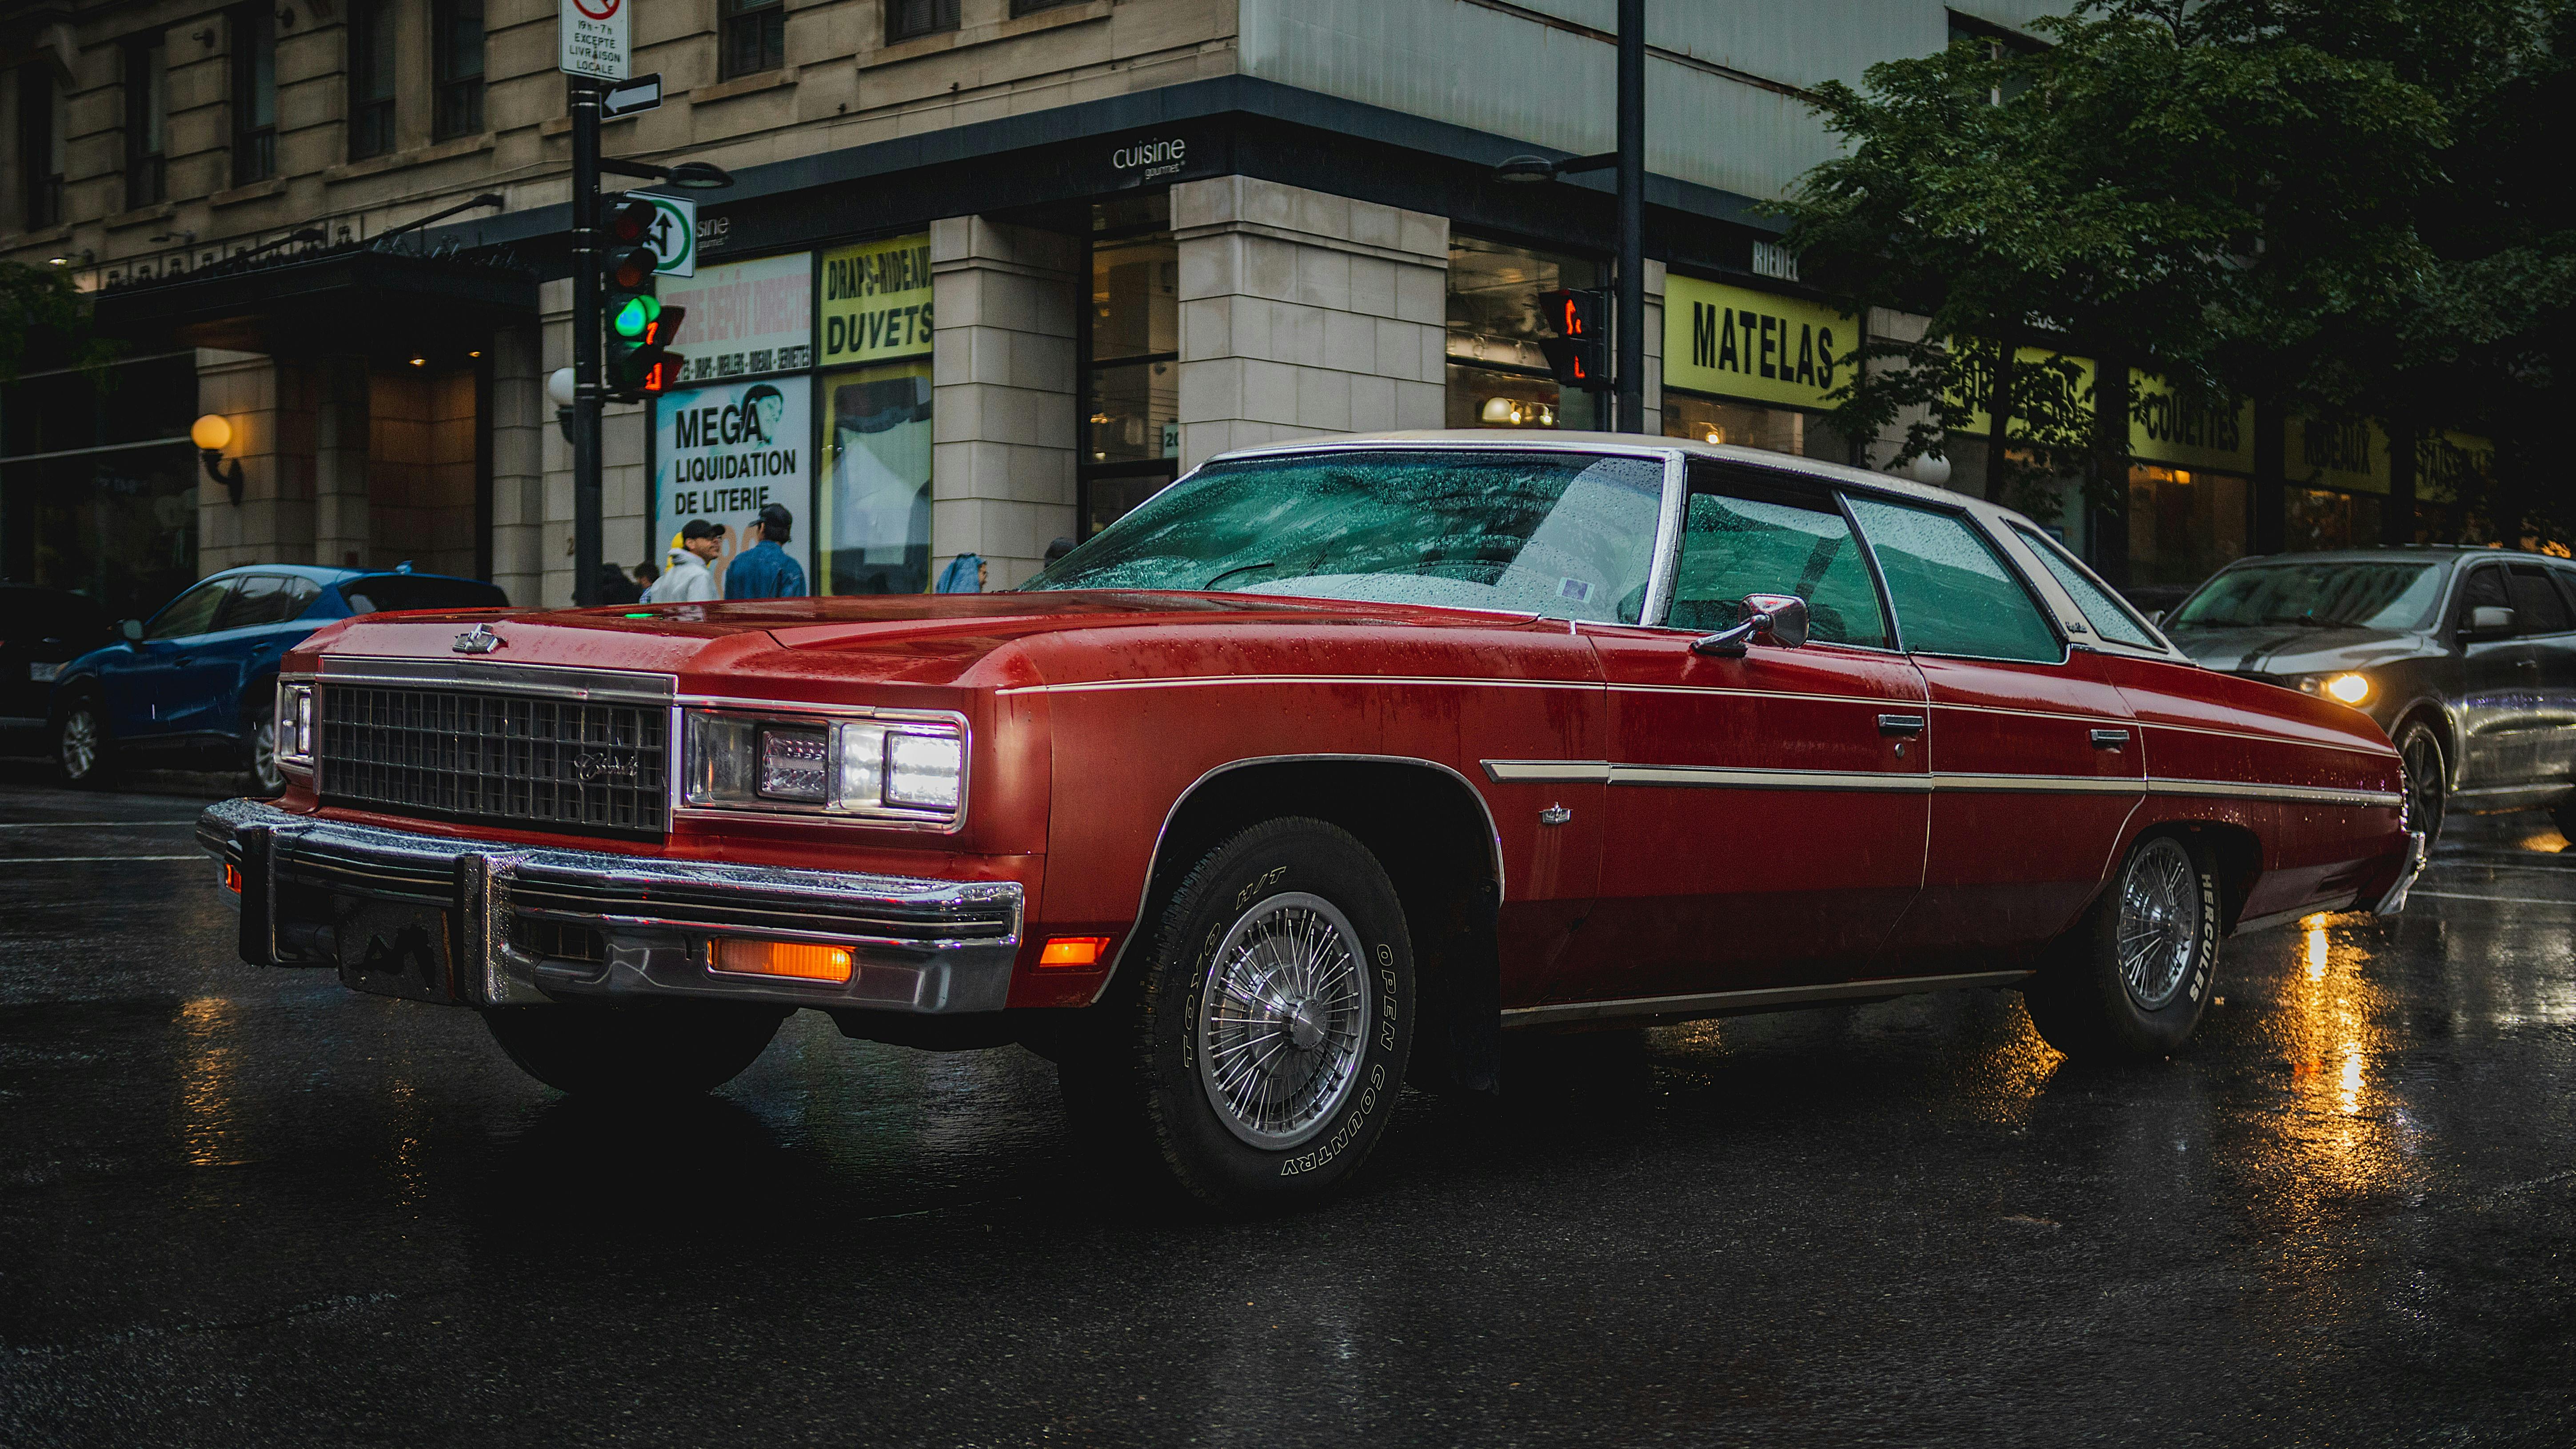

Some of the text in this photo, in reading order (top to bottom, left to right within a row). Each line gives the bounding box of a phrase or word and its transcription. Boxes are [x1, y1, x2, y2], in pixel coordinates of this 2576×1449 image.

[569, 45, 620, 63] LIVRAISON
[576, 59, 614, 75] LOCALE
[1113, 137, 1186, 169] cuisine
[696, 216, 731, 237] sine
[827, 302, 933, 355] DUVETS
[1693, 301, 1833, 390] MATELAS
[675, 401, 763, 449] MEGA
[675, 449, 796, 483] LIQUIDATION
[675, 486, 769, 515] DE LITERIE
[2189, 874, 2214, 1002] HERCULES
[1183, 922, 1221, 1068] TOYO
[1376, 943, 1397, 1052] OPEN
[1280, 1064, 1386, 1177] COUNTRY
